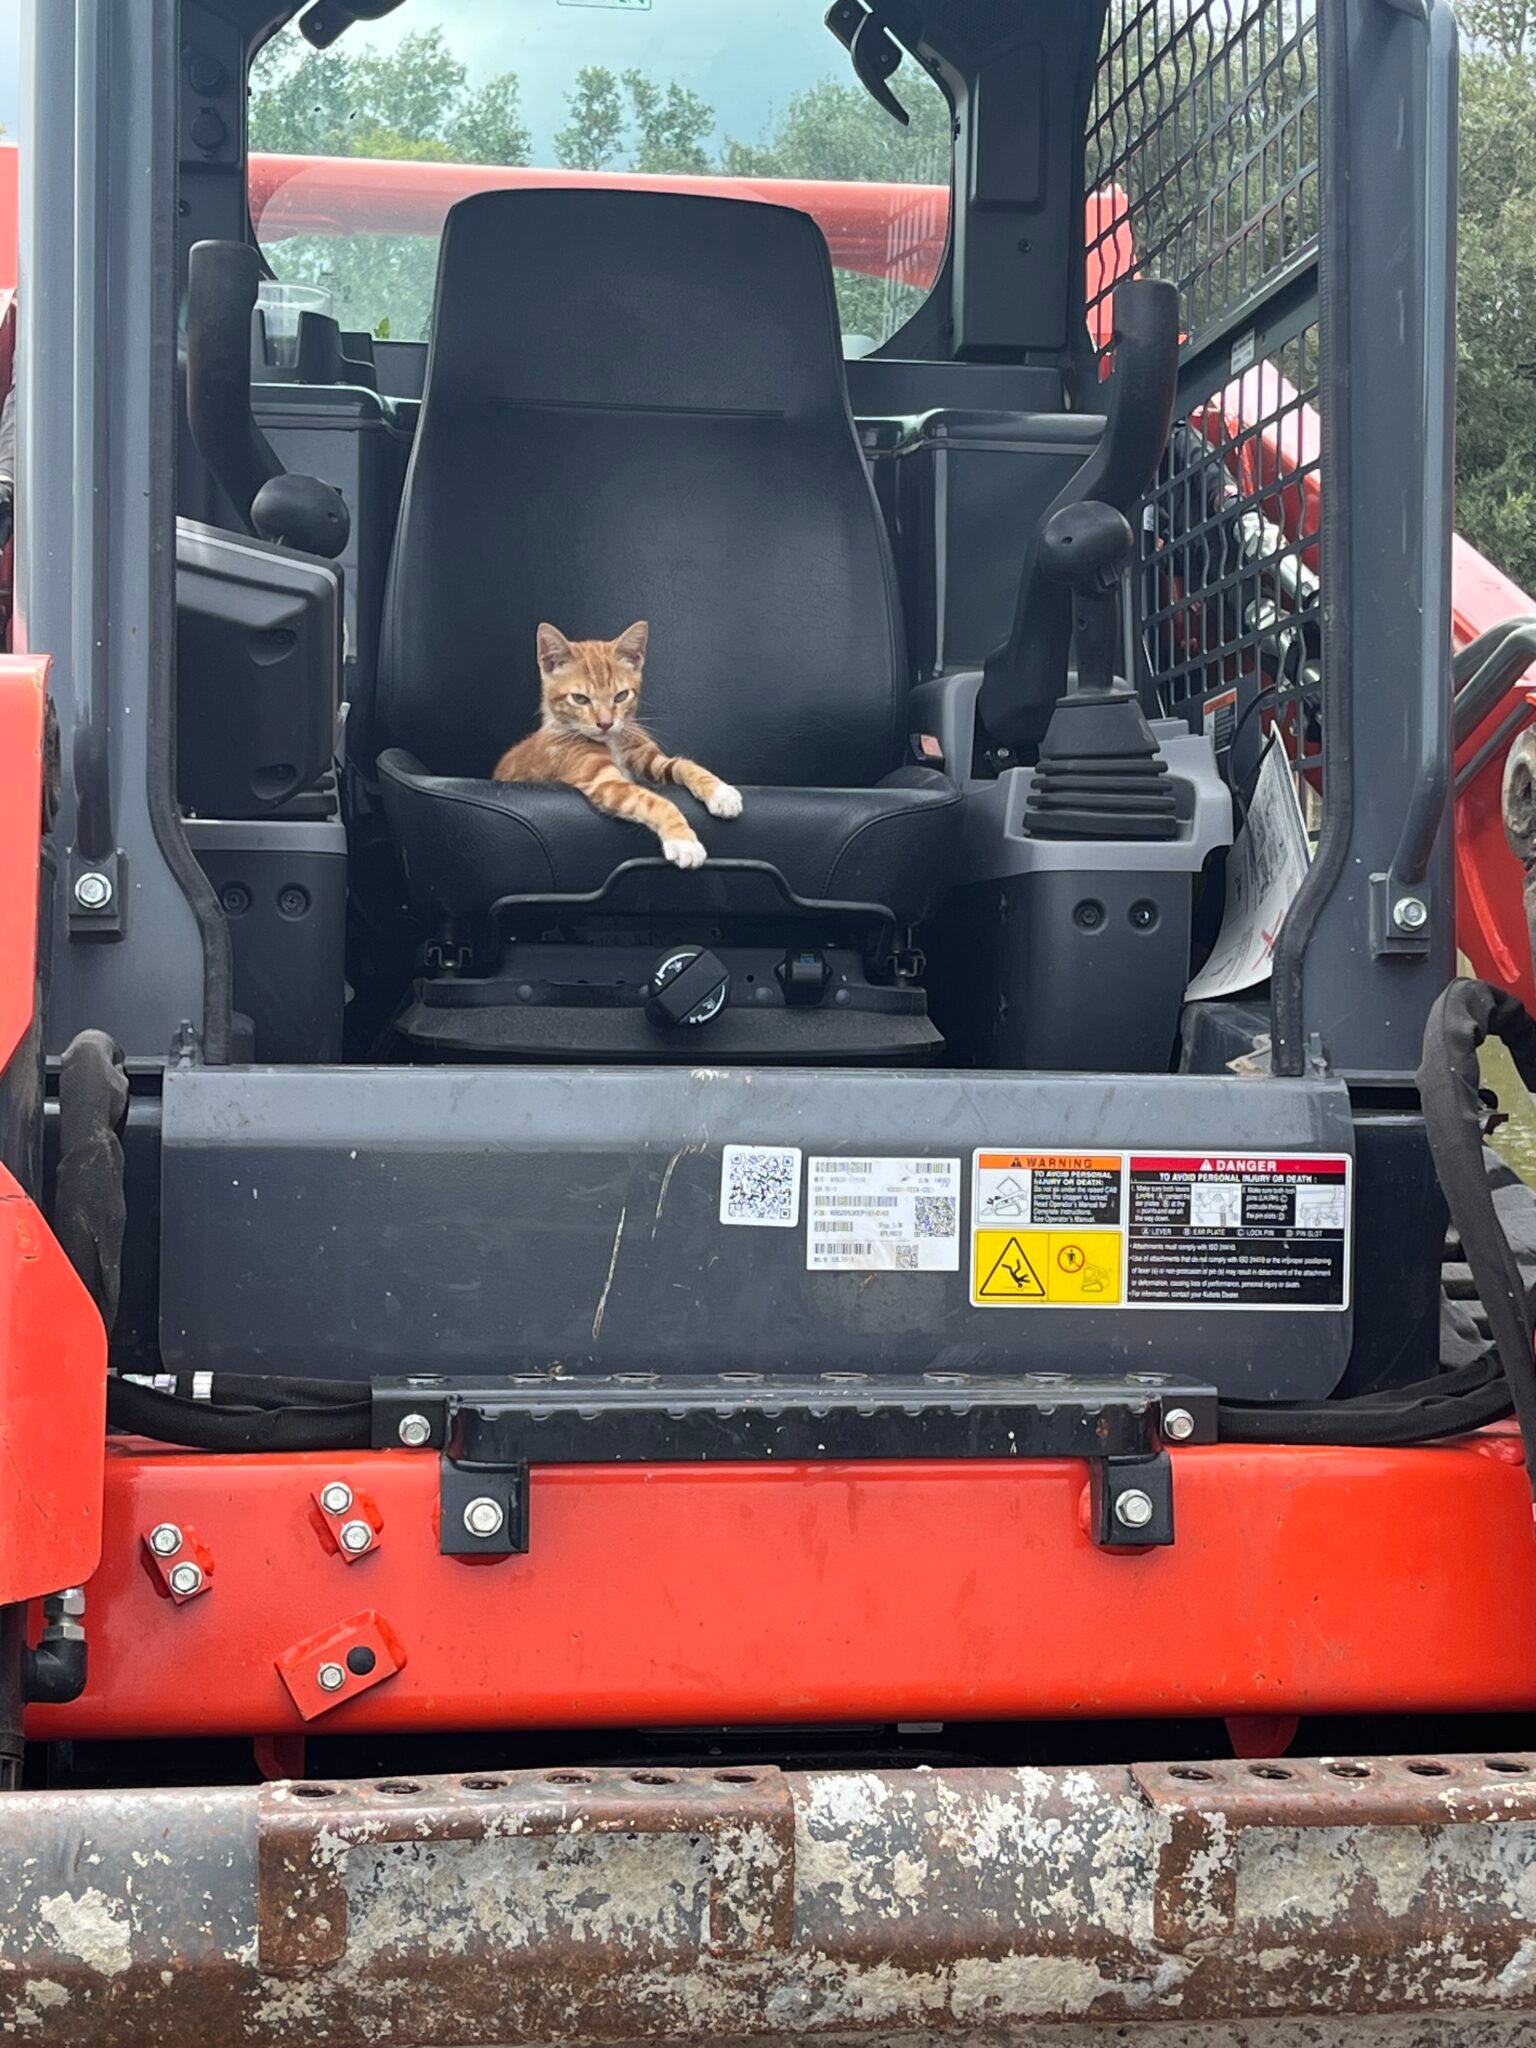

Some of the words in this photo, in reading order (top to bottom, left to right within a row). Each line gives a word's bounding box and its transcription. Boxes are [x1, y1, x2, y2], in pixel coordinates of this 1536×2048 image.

[1027, 1158, 1093, 1169] WARNING
[1216, 1160, 1277, 1172] DANGER
[1071, 1171, 1112, 1179] PERSONAL
[1159, 1173, 1170, 1181] TO
[1172, 1173, 1196, 1181] AVOID
[1198, 1173, 1240, 1182] PERSONAL
[1242, 1174, 1270, 1182] INJURY
[1272, 1174, 1284, 1182] OR
